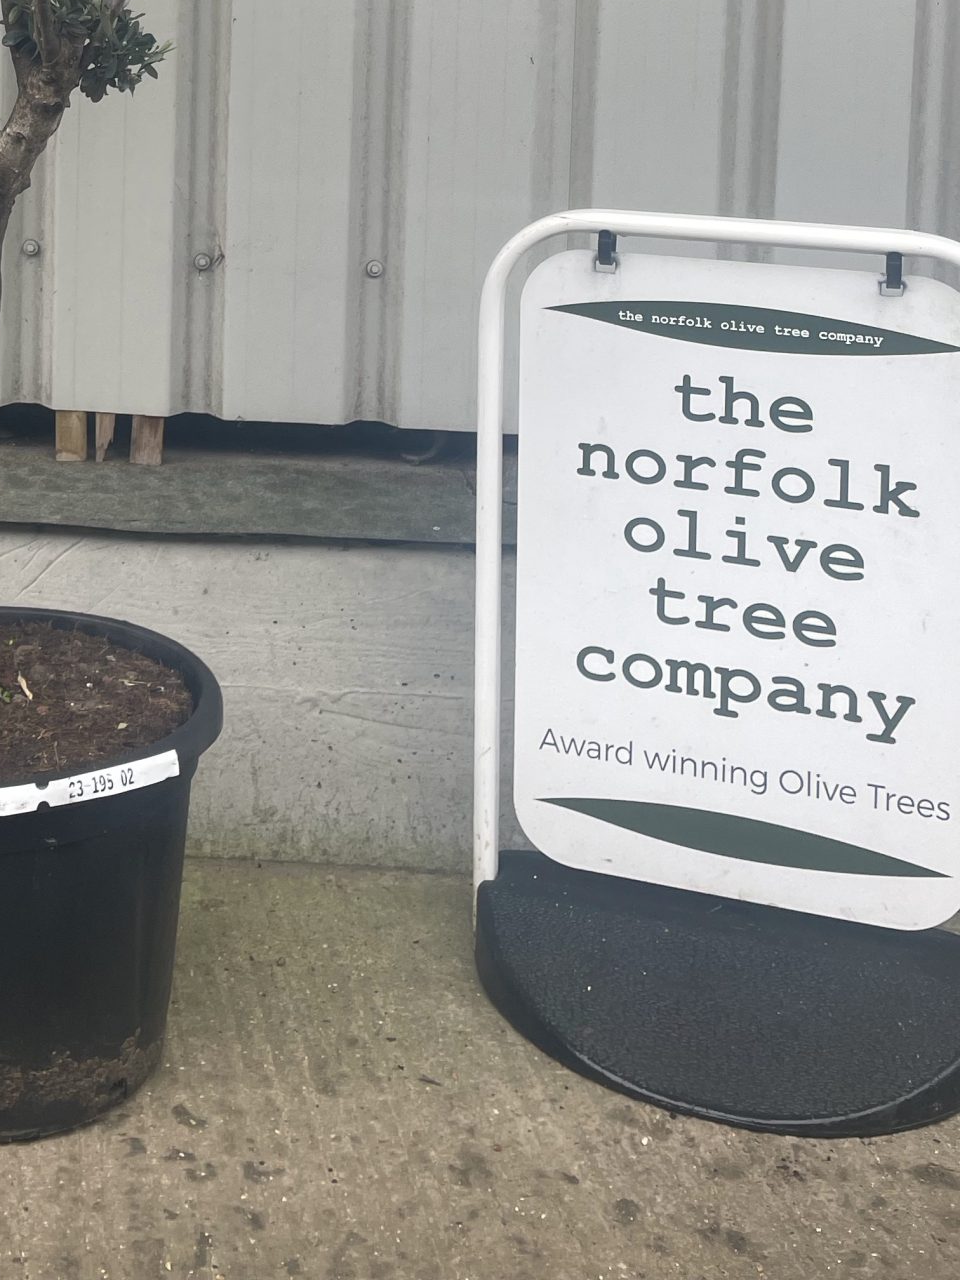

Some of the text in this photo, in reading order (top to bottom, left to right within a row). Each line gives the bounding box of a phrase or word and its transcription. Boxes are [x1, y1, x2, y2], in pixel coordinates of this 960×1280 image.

[618, 310, 884, 348] the norfolk olive tree company
[675, 374, 814, 433] the
[577, 442, 921, 517] norfolk
[624, 510, 865, 581] olive
[649, 578, 837, 648] tree
[577, 646, 916, 744] company
[120, 768, 135, 787] 02
[539, 728, 951, 821] Award winning Olive Trees
